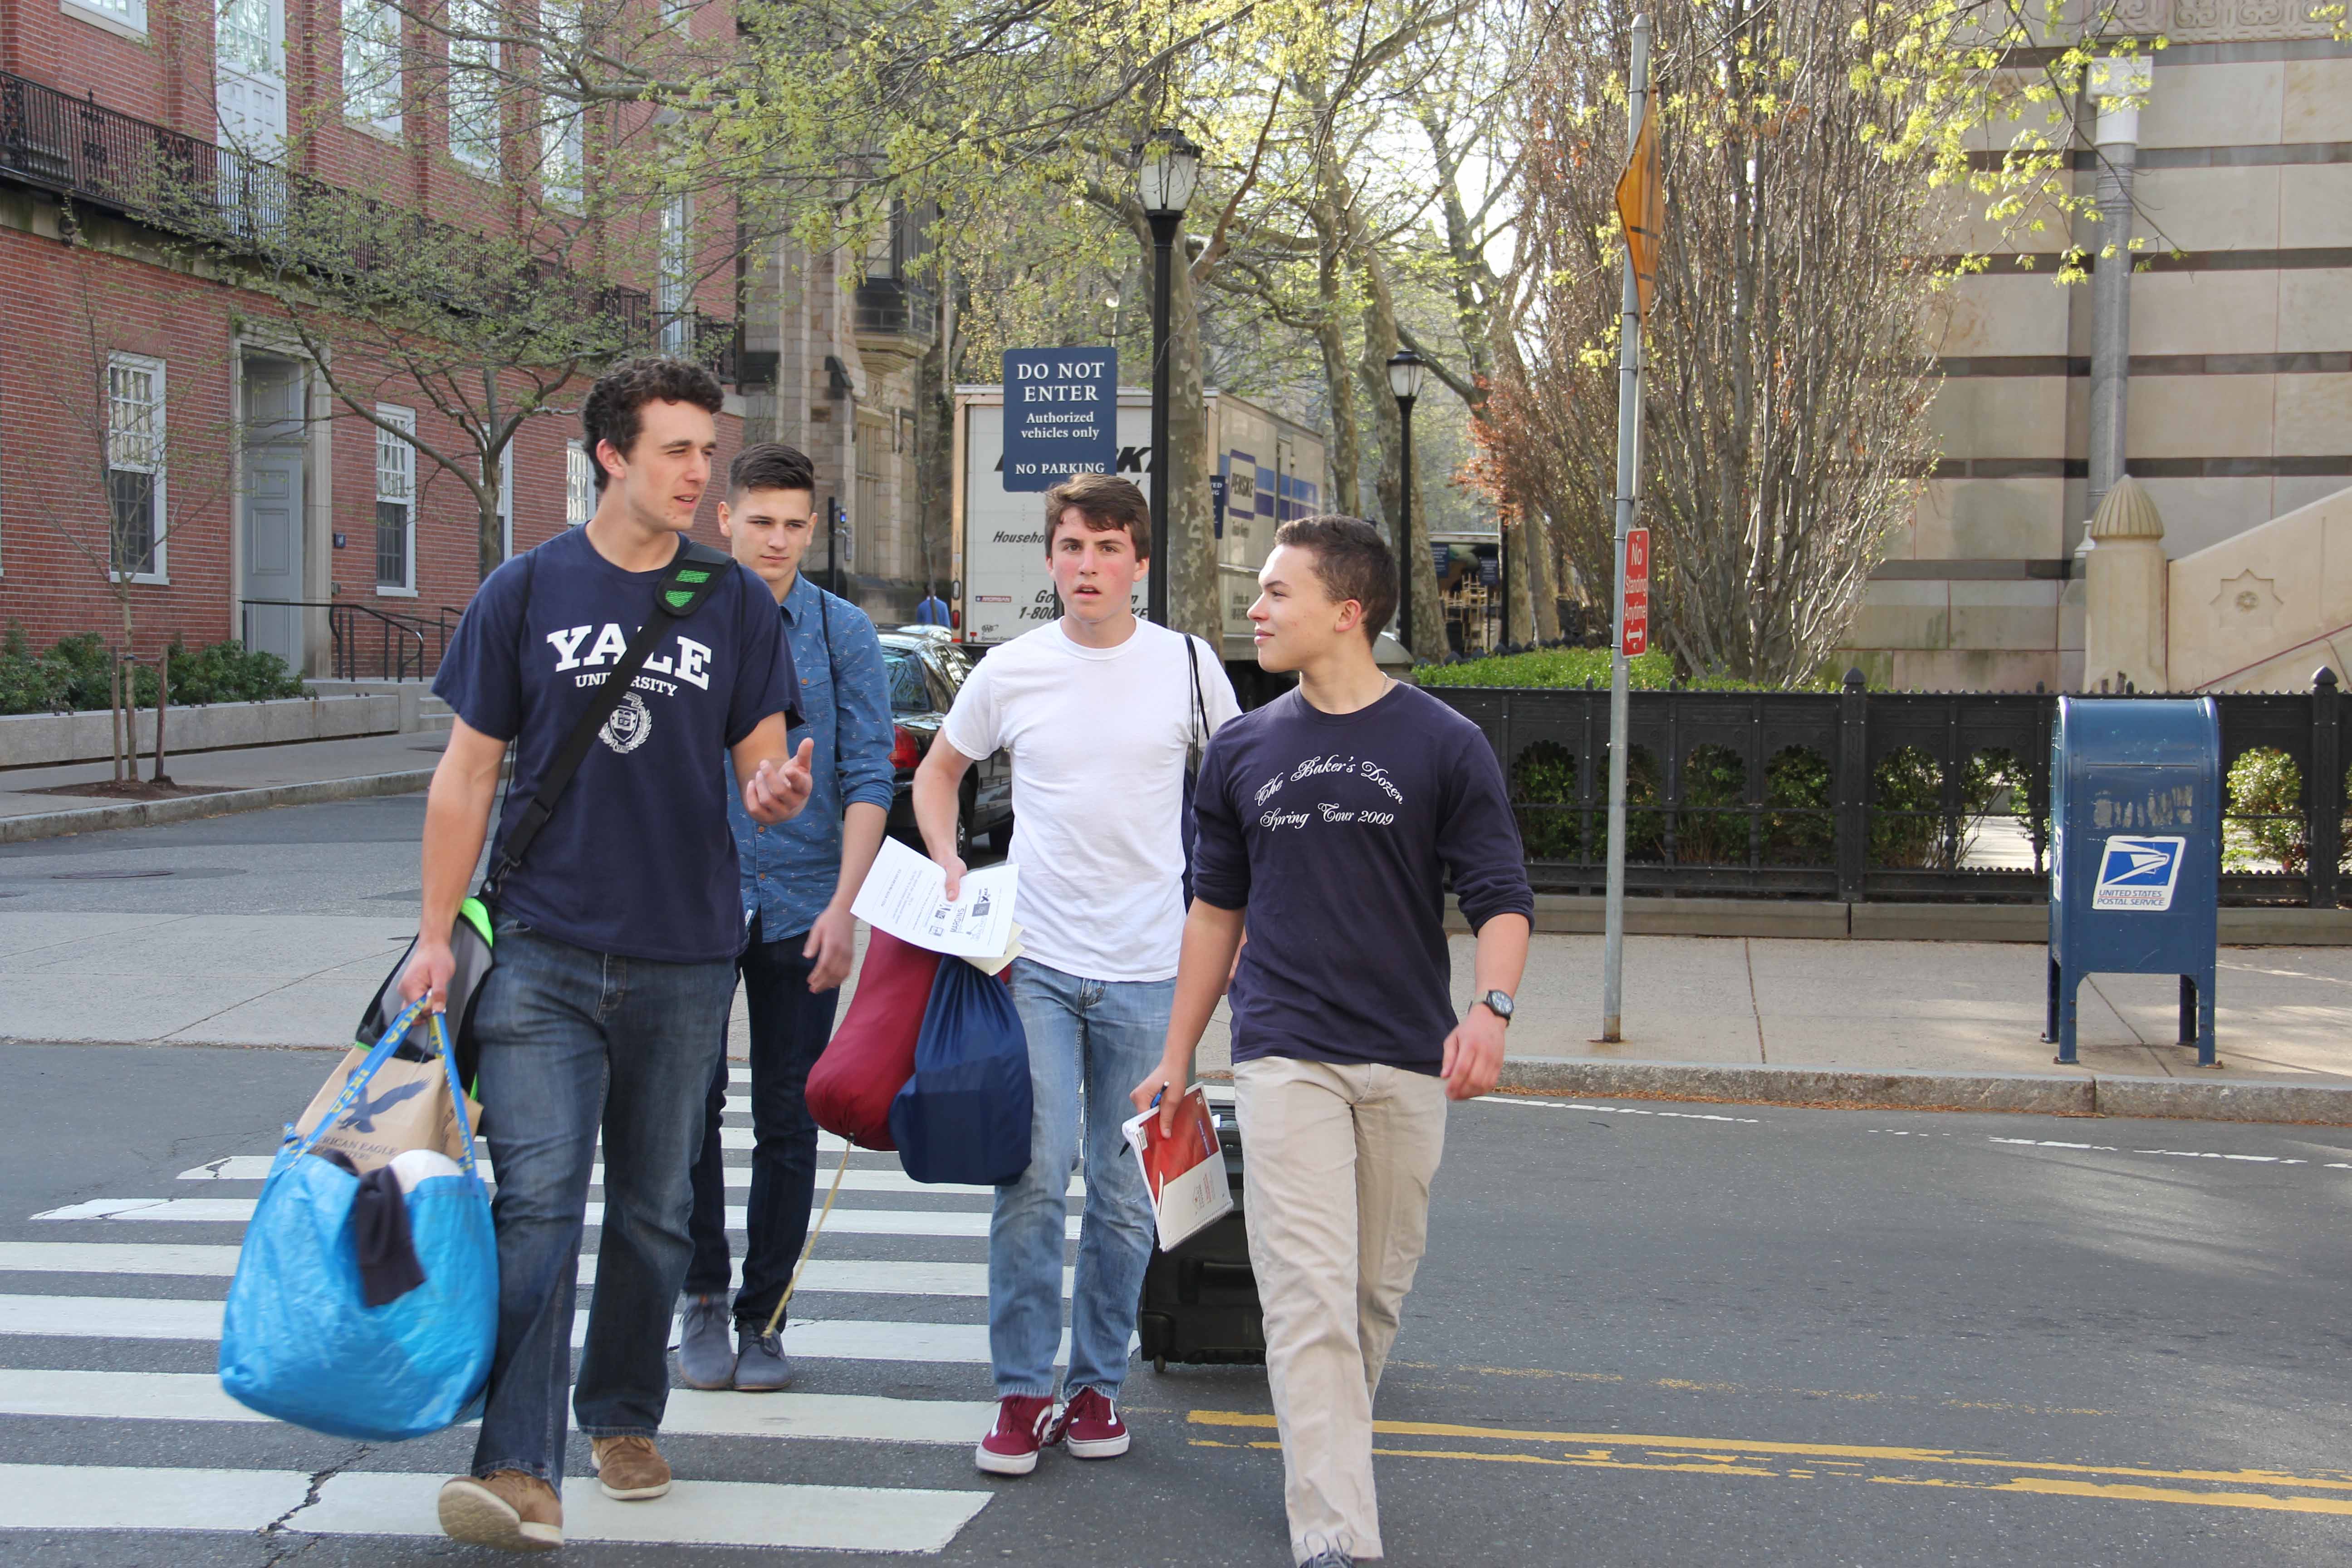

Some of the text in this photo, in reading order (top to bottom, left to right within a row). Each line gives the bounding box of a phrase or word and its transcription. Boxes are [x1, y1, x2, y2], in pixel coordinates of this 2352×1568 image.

[1017, 362, 1105, 380] DO NOT
[1023, 385, 1099, 402] ENTER
[1026, 411, 1094, 423] Authorized
[1021, 426, 1100, 440] vehicles only
[1015, 462, 1105, 475] NO PARKING
[993, 531, 1045, 543] Househo
[1631, 543, 1642, 566] No
[1625, 574, 1647, 597] Standing
[1624, 602, 1646, 626] Anytime
[575, 672, 678, 696] UNIRSITY
[1254, 755, 1403, 806] The Baker's Dozen
[1259, 803, 1394, 832] Spring Tour 2009
[329, 1068, 370, 1113] IKEA
[359, 1142, 399, 1156] EAGLE
